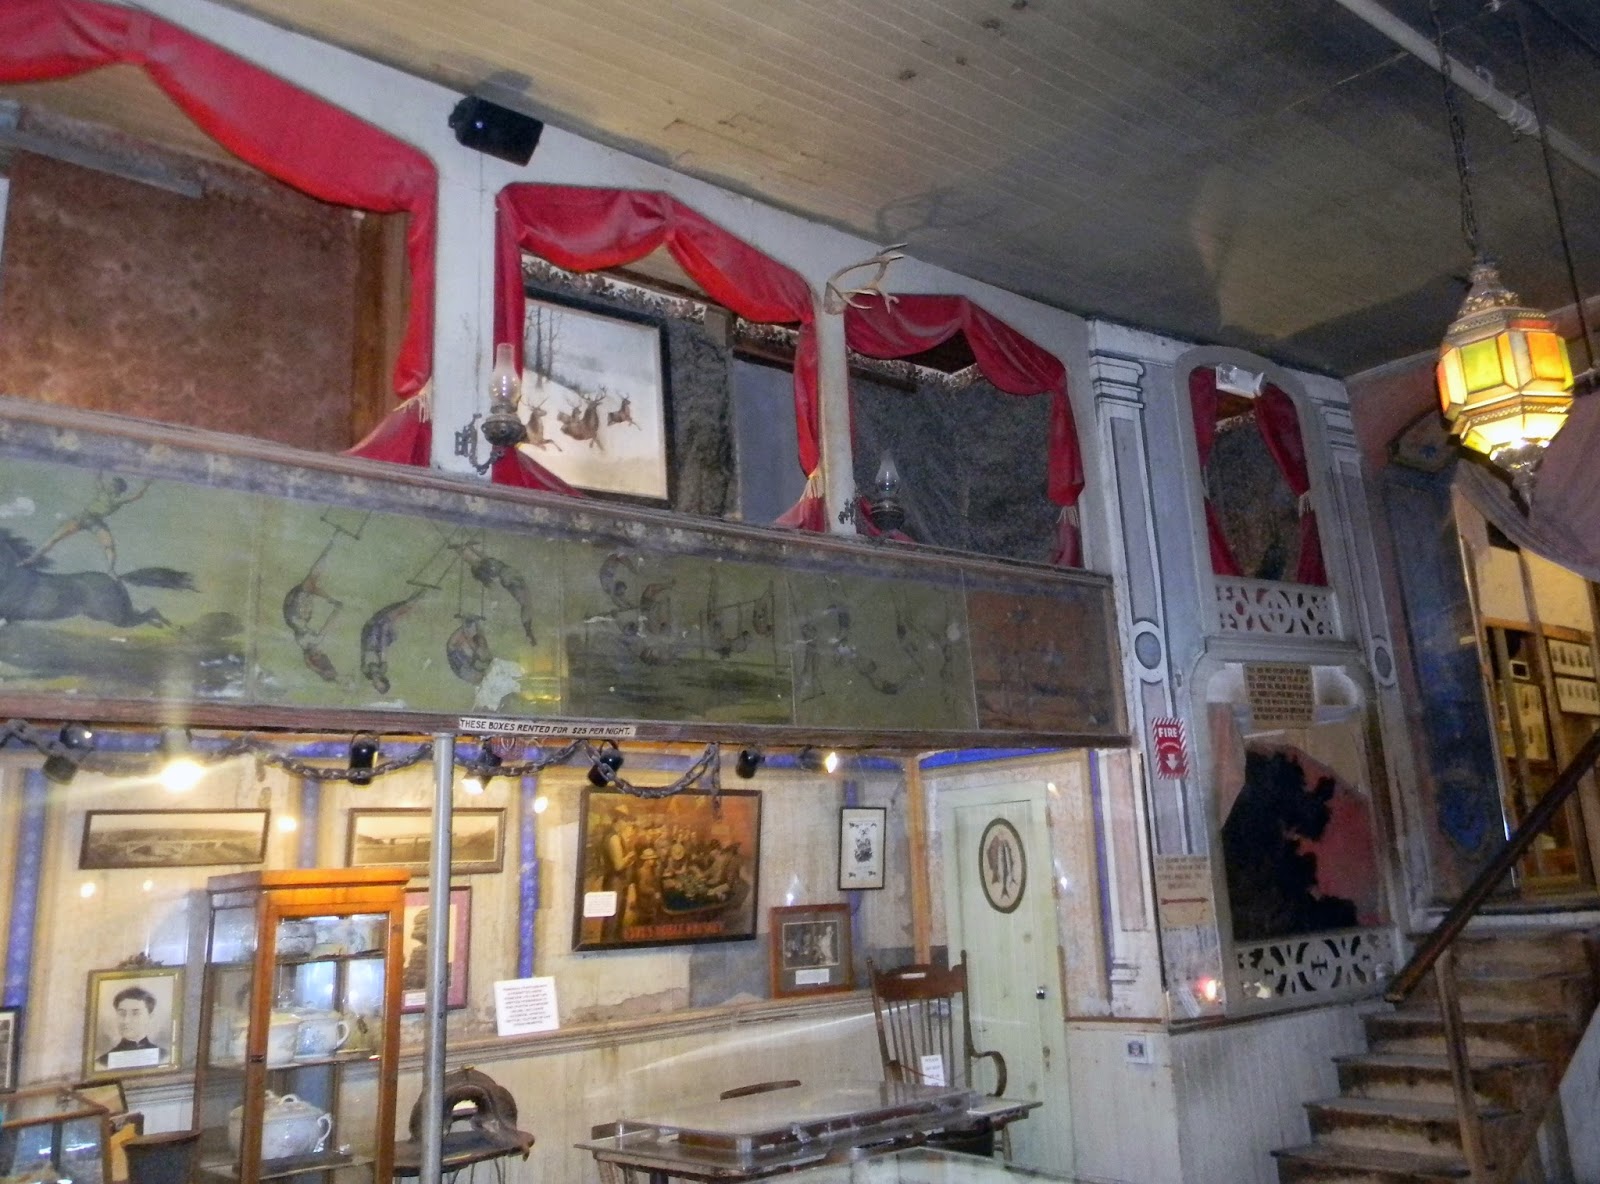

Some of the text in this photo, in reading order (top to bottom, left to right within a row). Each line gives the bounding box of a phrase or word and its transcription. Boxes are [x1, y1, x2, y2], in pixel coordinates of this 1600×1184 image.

[460, 719, 630, 736] THESE BOXES RENTED FOR $25 PER NIGHT.
[1157, 727, 1178, 738] FIRE
